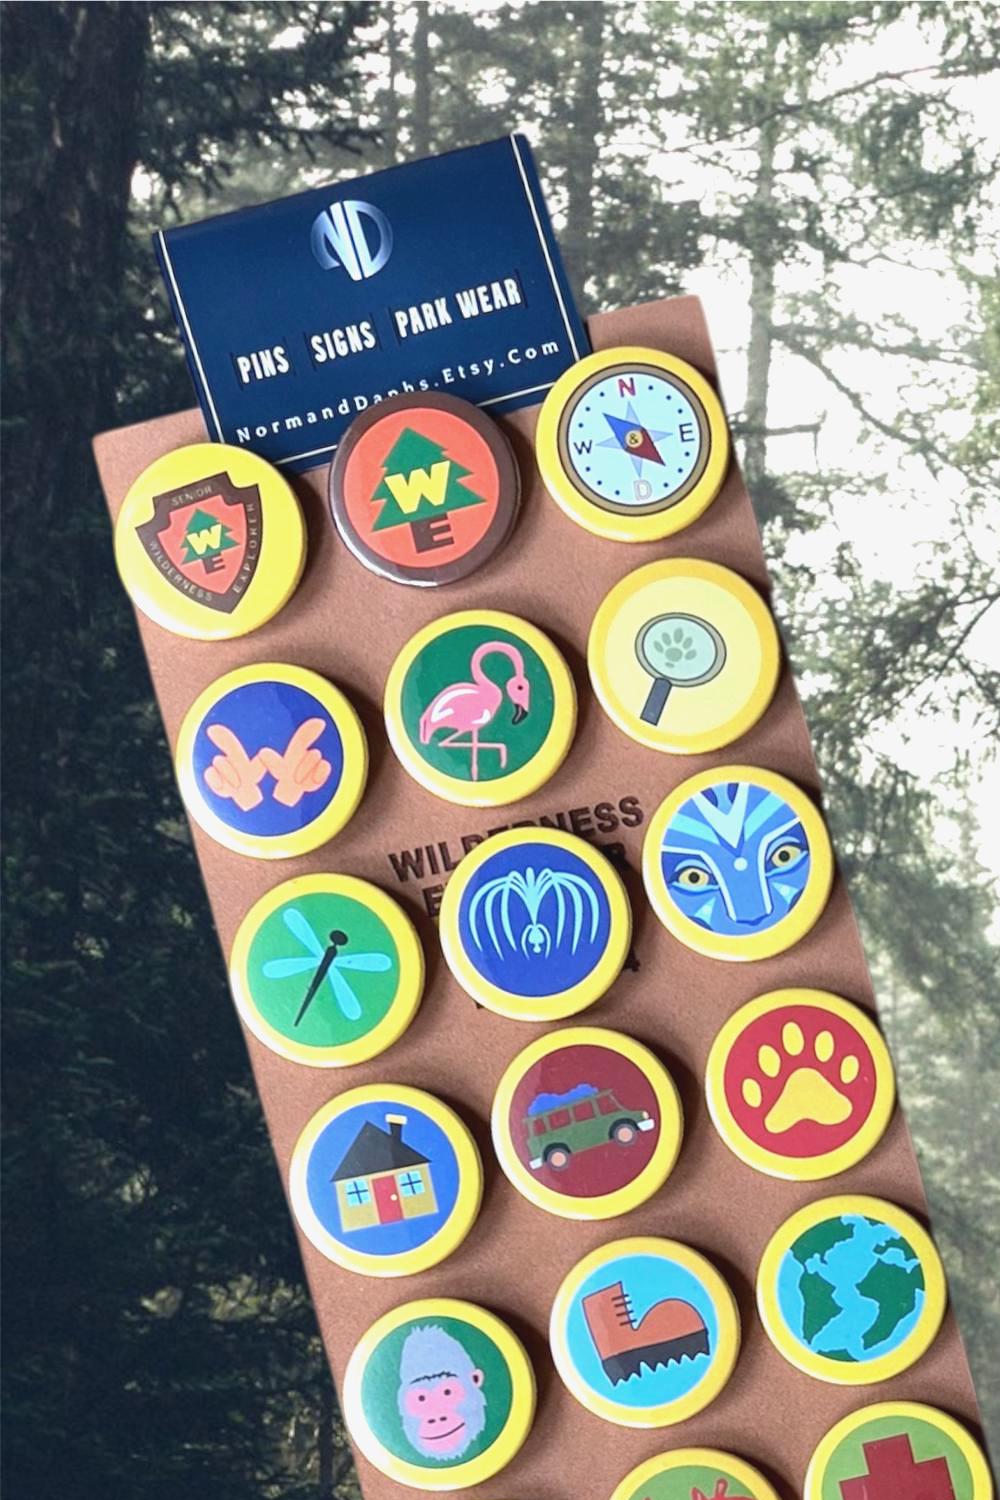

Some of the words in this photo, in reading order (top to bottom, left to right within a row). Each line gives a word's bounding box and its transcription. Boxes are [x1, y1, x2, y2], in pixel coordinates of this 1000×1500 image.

[236, 345, 290, 384] PINS
[310, 321, 376, 363] SIGNS
[395, 297, 453, 338] PARK
[455, 278, 522, 319] WEAR
[617, 377, 636, 398] N
[573, 440, 593, 456] W
[678, 422, 695, 443] E
[171, 485, 213, 507] SENOR
[384, 460, 451, 514] W
[633, 479, 653, 501] D
[186, 523, 222, 555] W
[410, 512, 455, 554] E
